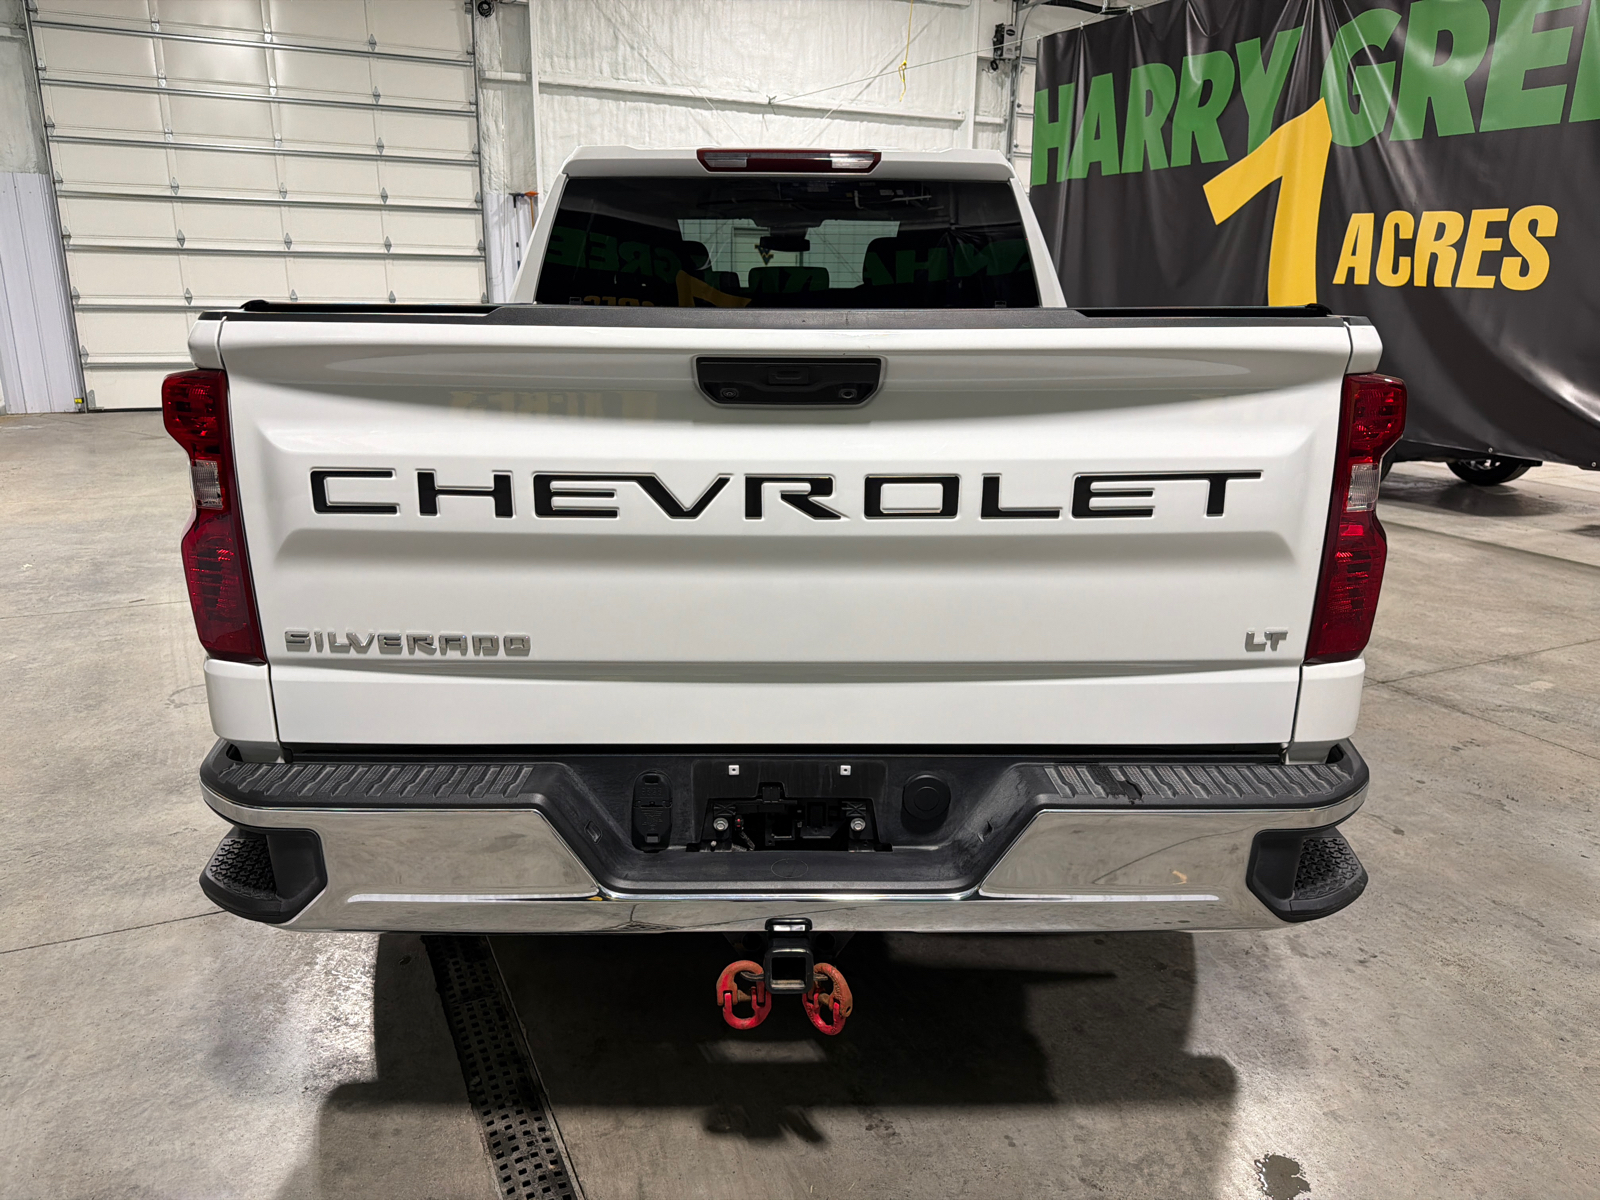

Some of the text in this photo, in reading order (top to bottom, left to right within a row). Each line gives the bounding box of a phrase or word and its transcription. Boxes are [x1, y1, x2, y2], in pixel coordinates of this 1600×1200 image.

[1031, 0, 1600, 186] HARRY GRE
[1333, 205, 1558, 291] ACRES
[310, 467, 1263, 519] CHEVROLET
[285, 630, 531, 656] SILVERADO
[1245, 630, 1288, 652] LT
